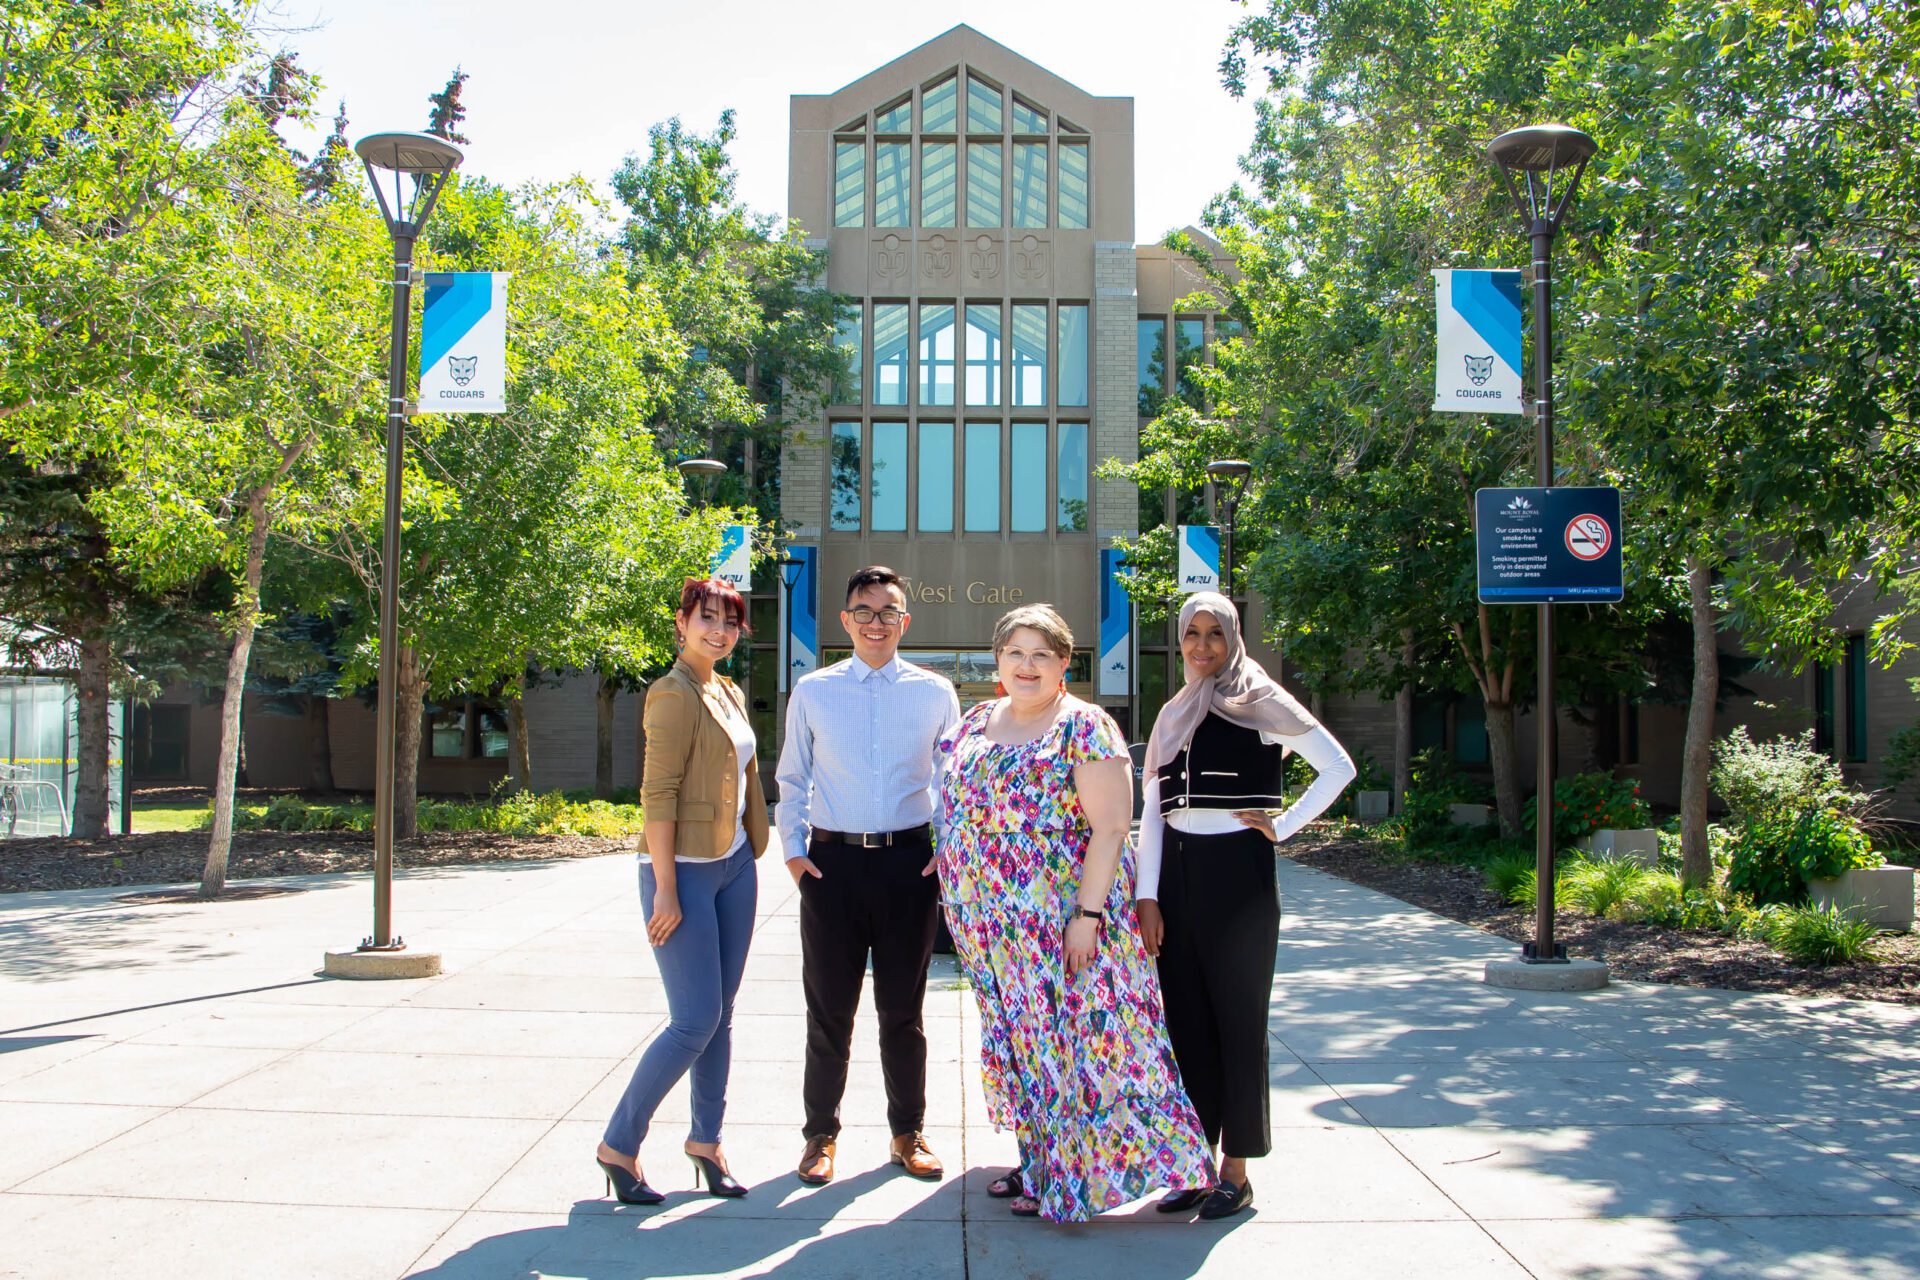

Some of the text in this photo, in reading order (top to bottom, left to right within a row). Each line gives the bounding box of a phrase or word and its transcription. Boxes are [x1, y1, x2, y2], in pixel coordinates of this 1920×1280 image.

[439, 390, 485, 399] COUGARS
[1456, 389, 1502, 399] COUGARS
[1186, 575, 1212, 584] MRU
[966, 581, 1024, 604] Gate
